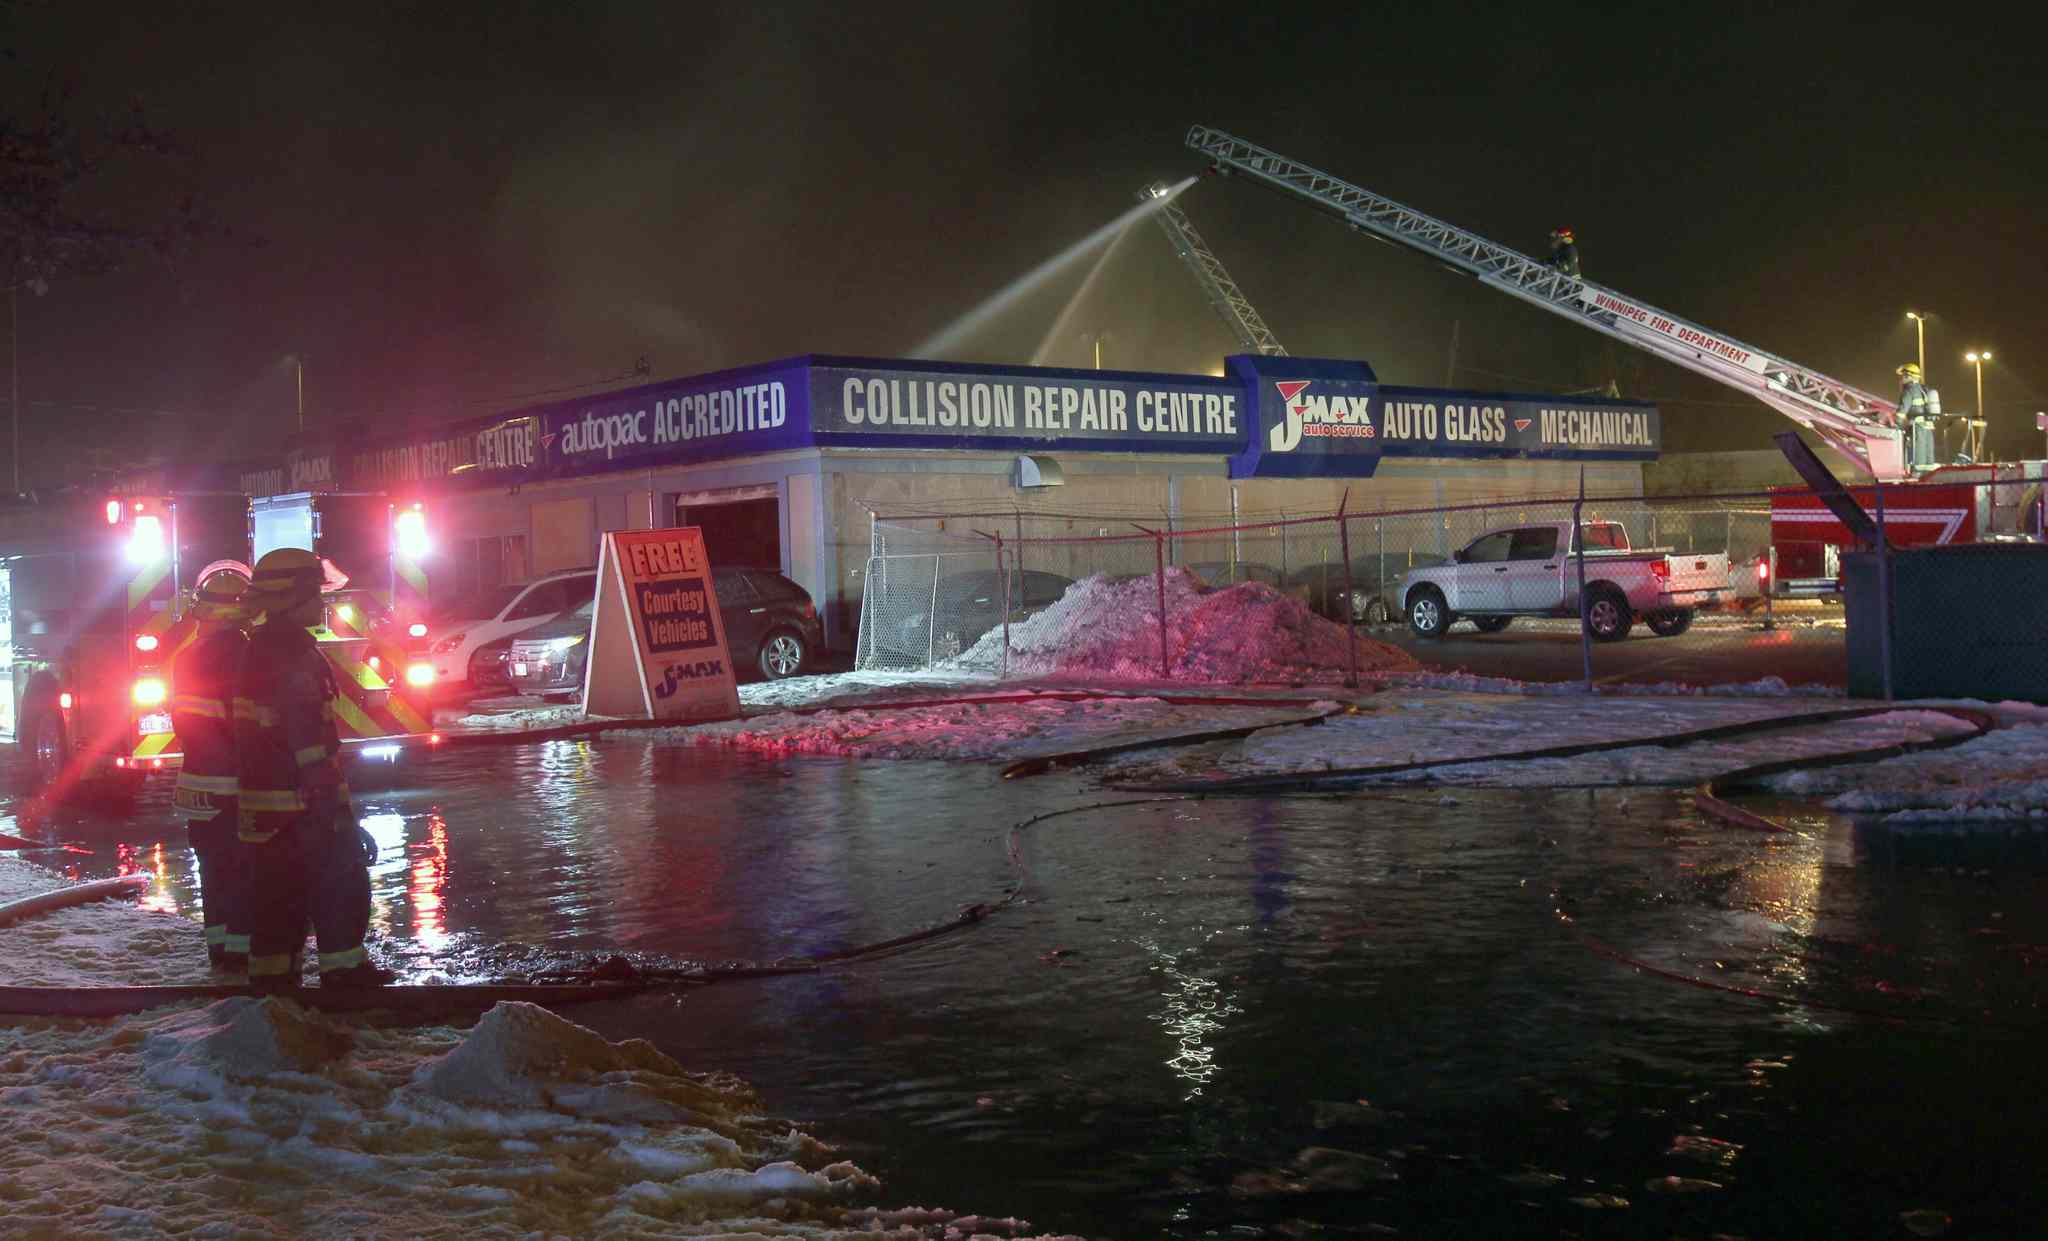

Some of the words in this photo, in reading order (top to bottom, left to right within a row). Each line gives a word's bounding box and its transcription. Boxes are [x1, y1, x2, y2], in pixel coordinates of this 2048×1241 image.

[1595, 293, 1648, 322] WINNIPEG
[1650, 316, 1676, 334] FIRE
[1678, 328, 1751, 364] DEPARTMENT
[561, 410, 648, 460] autopac
[653, 382, 786, 444] ACCREDITED
[843, 377, 1015, 428] COLLISION
[1025, 385, 1127, 432] REPAIR
[1137, 390, 1237, 434] CENTRE
[1383, 402, 1437, 440] AUTO
[1444, 405, 1507, 442] GLASS
[1541, 409, 1653, 445] MECHANICAL
[476, 426, 534, 471] CENTRE
[629, 538, 699, 576] FREE
[644, 588, 705, 616] Courtesy
[651, 618, 708, 645] Vehicles
